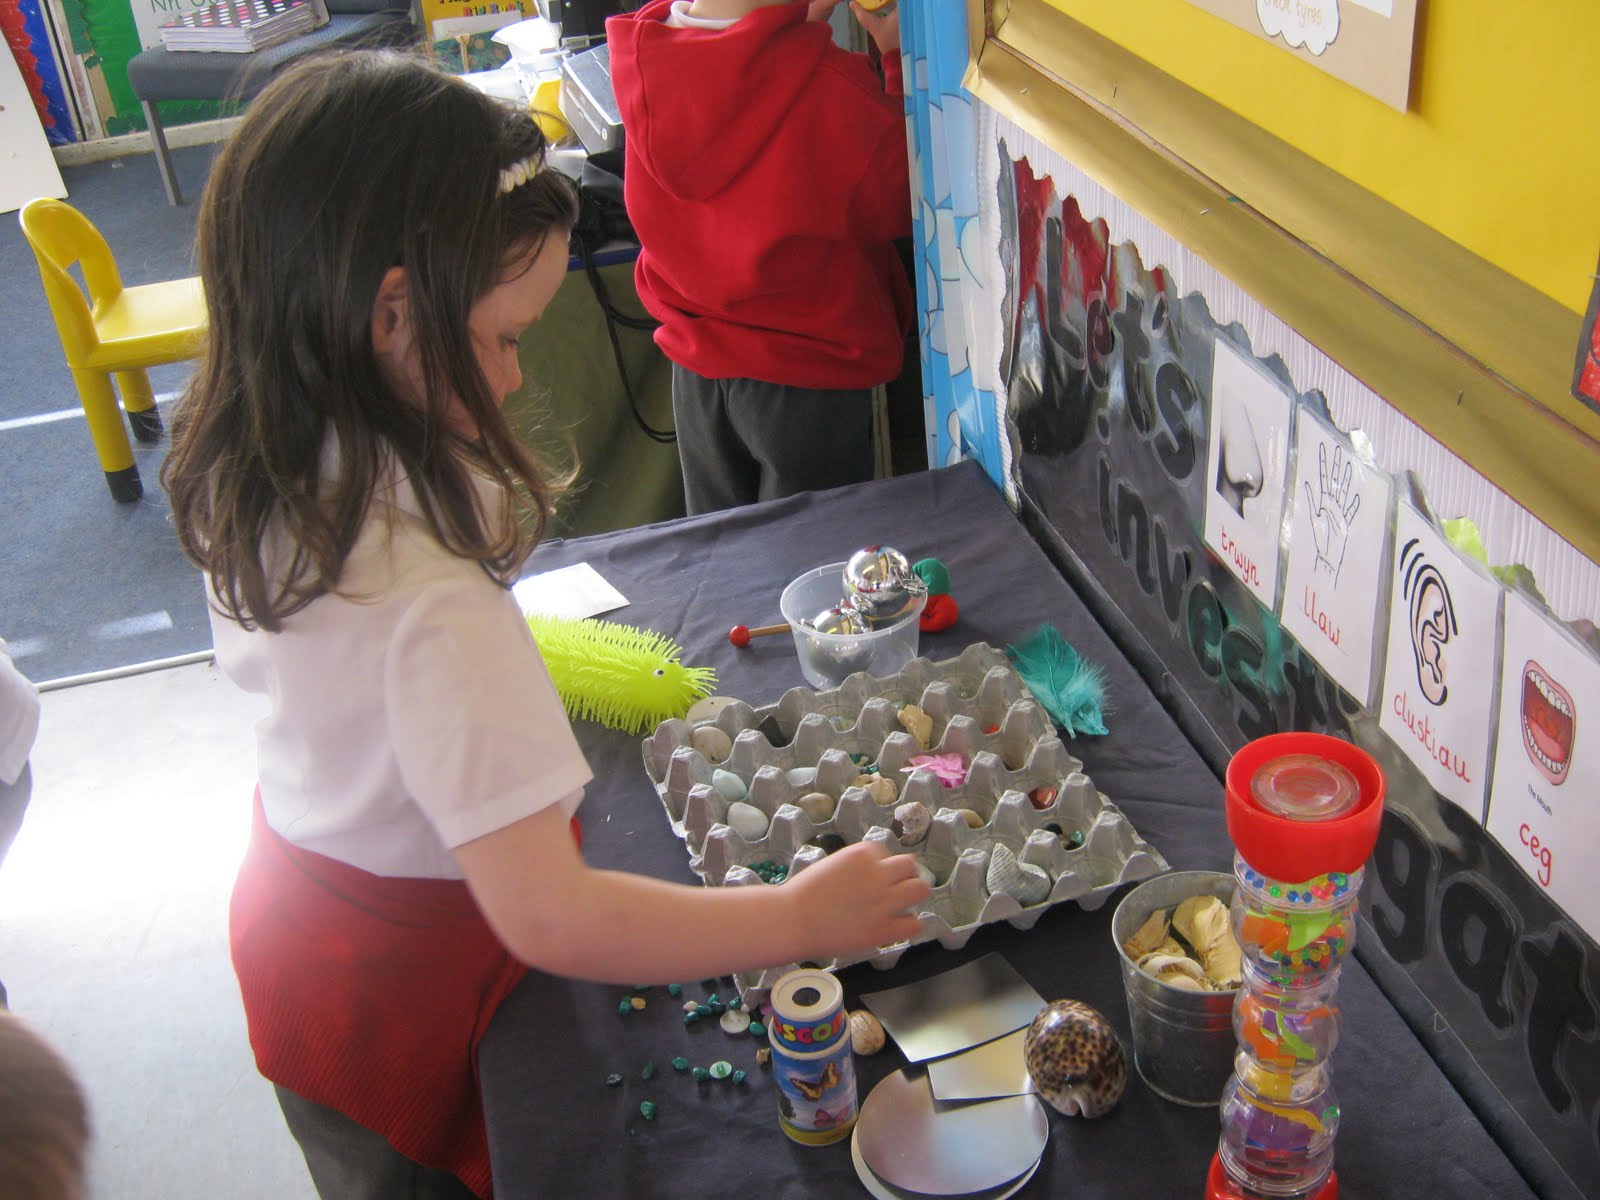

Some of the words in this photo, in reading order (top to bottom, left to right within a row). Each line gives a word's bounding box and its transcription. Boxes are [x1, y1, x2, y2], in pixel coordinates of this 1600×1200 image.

[1221, 523, 1260, 587] trwyn
[1303, 585, 1341, 646] llaw
[1393, 691, 1471, 783] clustiau
[1527, 783, 1537, 799] The
[1536, 793, 1553, 816] Mouth
[1519, 823, 1552, 887] ceg
